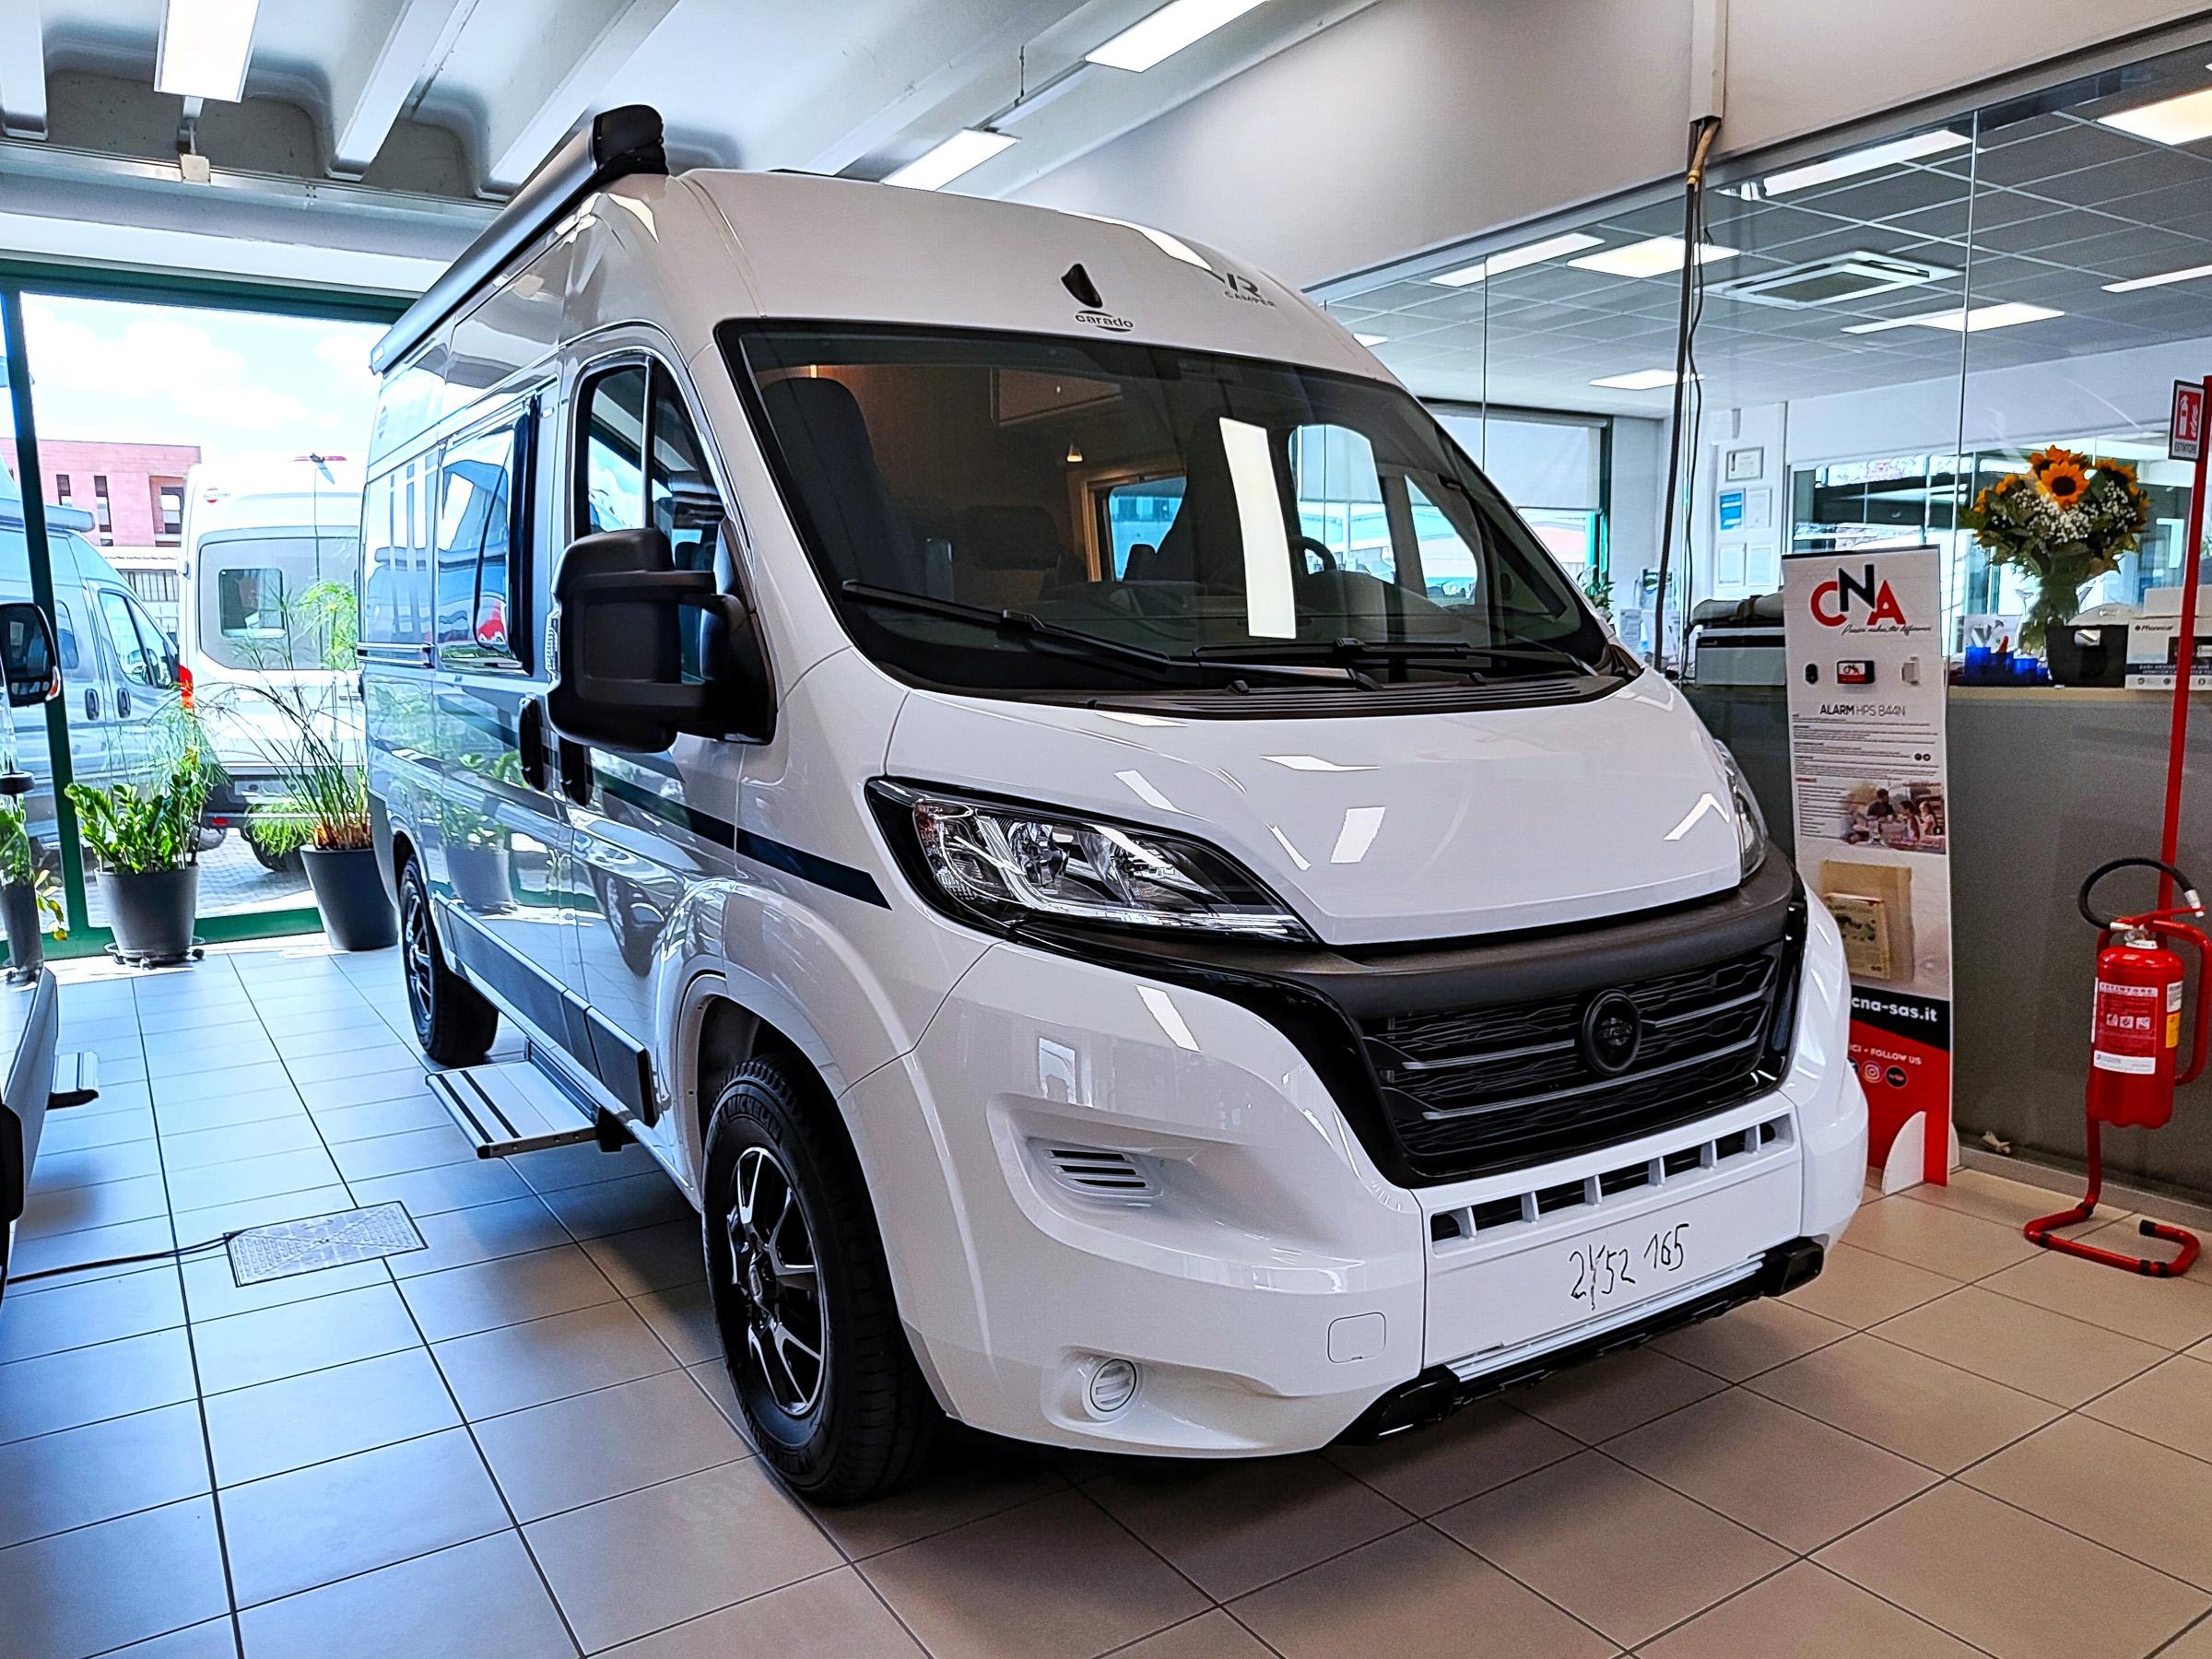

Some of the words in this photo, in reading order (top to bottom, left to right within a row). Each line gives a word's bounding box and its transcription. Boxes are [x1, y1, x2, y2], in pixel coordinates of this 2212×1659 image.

[1075, 312, 1134, 328] carado
[1810, 564, 1907, 627] CNA
[1819, 704, 1854, 715] ALARM
[1855, 705, 1877, 716] HPS
[1878, 705, 1906, 717] 844N
[1870, 1048, 1907, 1061] FOLLOW
[1908, 1055, 1922, 1065] US
[1643, 1223, 1689, 1272] 165
